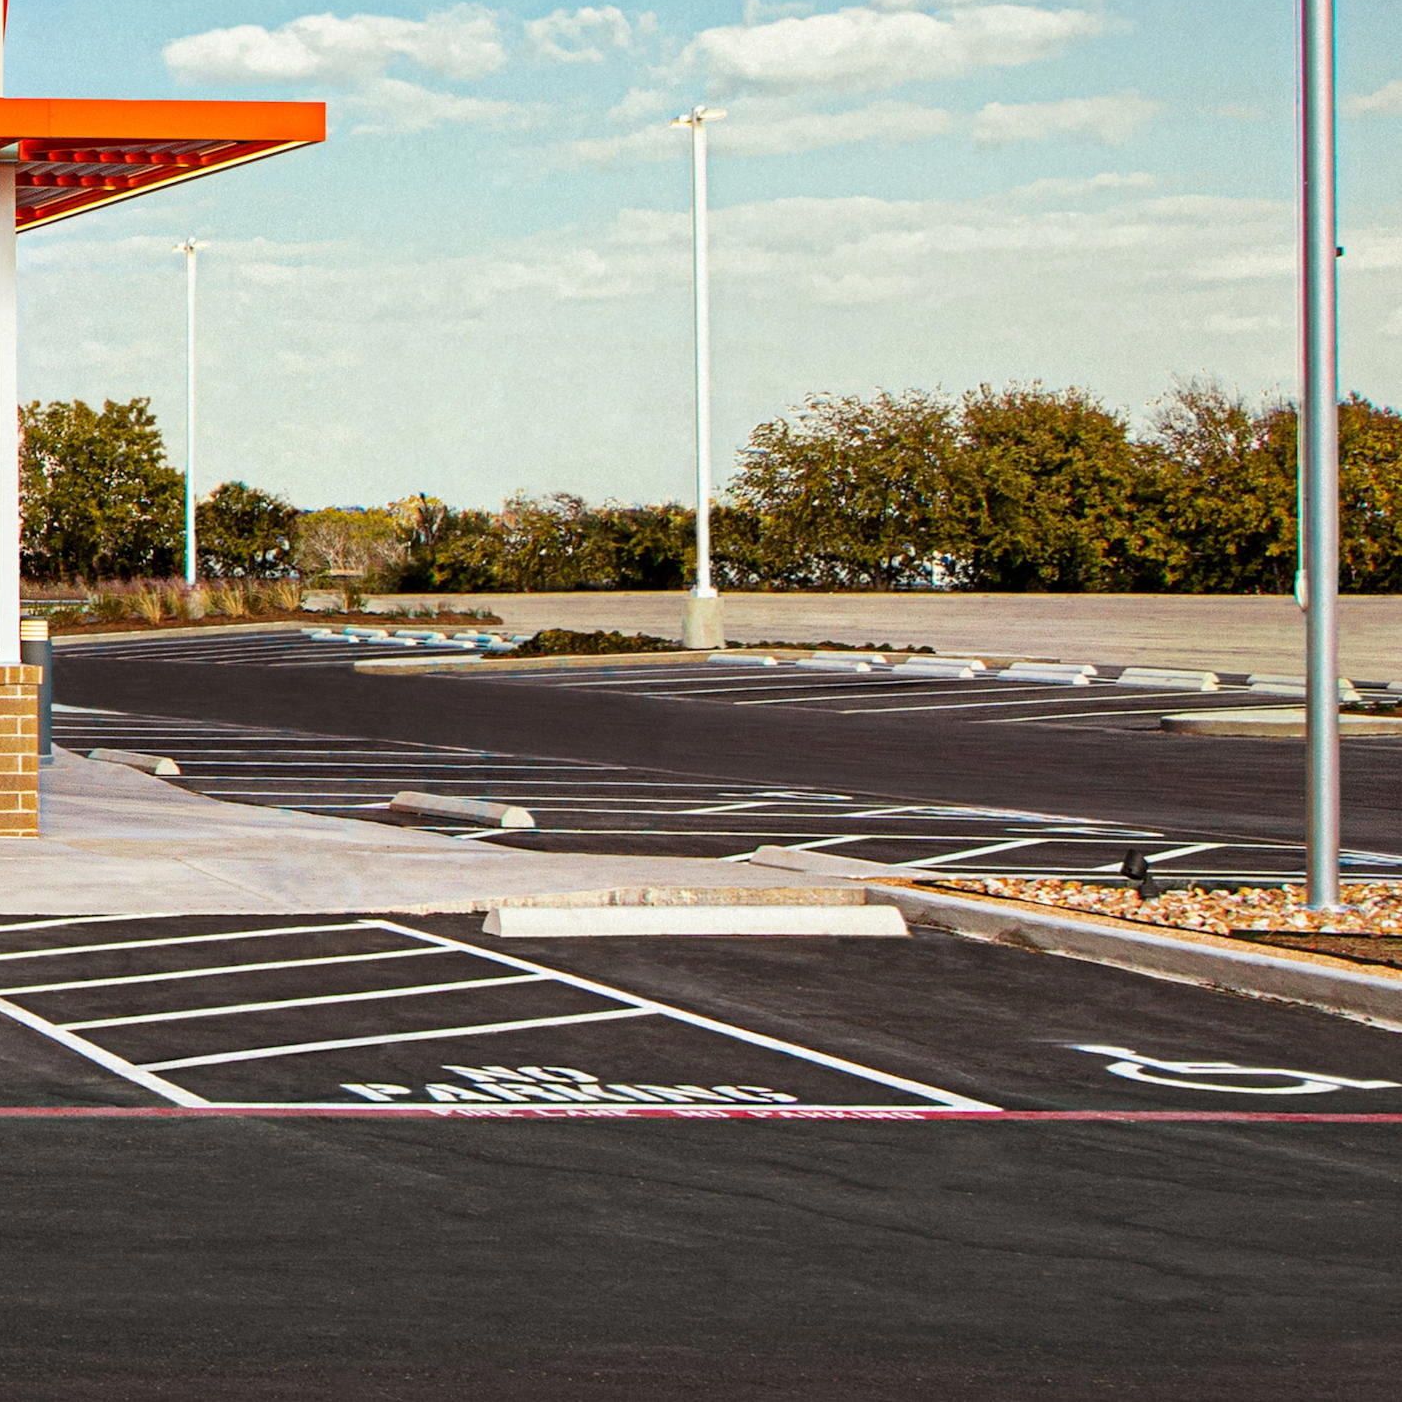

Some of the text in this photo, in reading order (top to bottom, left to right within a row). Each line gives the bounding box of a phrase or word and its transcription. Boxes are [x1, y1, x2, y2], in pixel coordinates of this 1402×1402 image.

[441, 1065, 599, 1083] NO
[339, 1083, 798, 1103] PARKING
[673, 1109, 731, 1118] NO
[746, 1110, 926, 1119] PARKING
